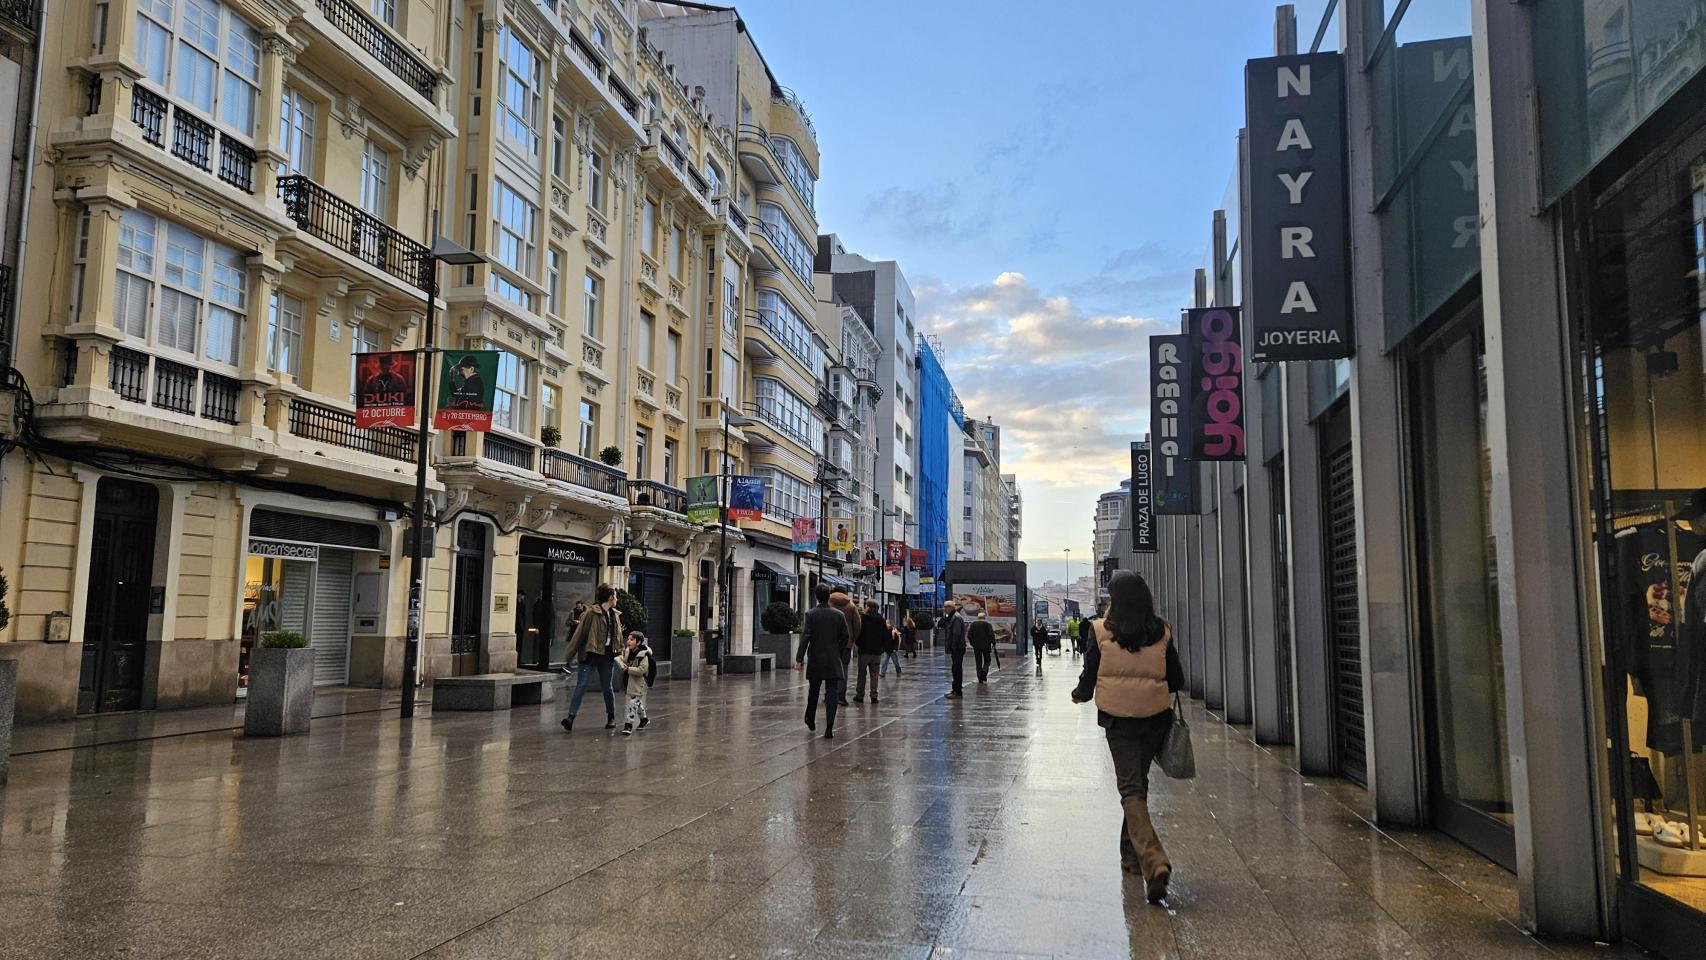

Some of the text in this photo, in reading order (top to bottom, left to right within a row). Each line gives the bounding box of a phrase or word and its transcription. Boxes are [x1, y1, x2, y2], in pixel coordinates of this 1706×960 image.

[1276, 64, 1318, 314] NAYRA
[1259, 328, 1341, 347] JOYERIA
[1201, 309, 1245, 456] yoigo
[364, 392, 404, 403] DUKI
[362, 408, 406, 418] 12 OCTUBRE
[458, 413, 487, 421] SETEMBRO
[1138, 454, 1148, 485] LUGO
[1139, 486, 1149, 504] DE
[1140, 506, 1150, 544] PRAZA
[250, 542, 317, 558] omen'secret
[547, 547, 576, 560] MANGO
